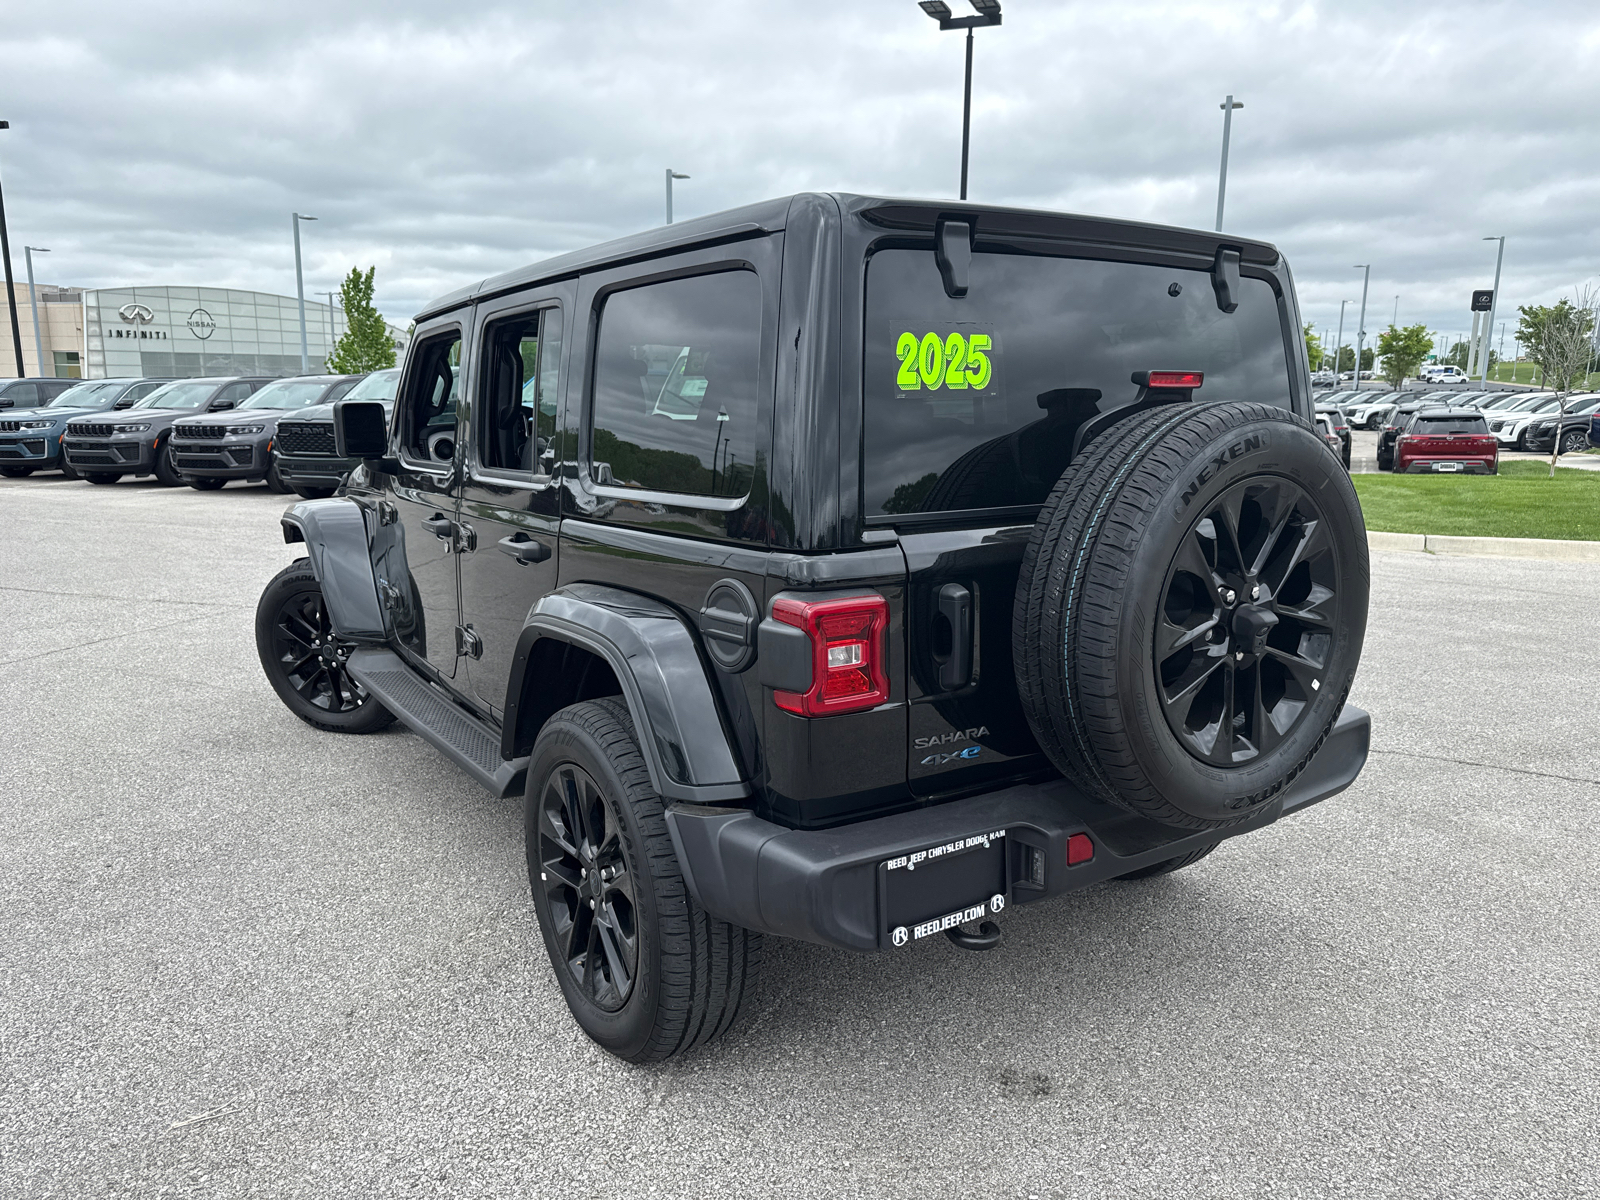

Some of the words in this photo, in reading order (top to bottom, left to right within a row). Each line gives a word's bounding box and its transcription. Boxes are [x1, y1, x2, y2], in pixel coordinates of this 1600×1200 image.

[109, 329, 167, 340] INFINITI
[186, 320, 216, 328] NISSAN
[896, 331, 992, 391] 2025
[291, 427, 325, 435] RAM
[1180, 435, 1261, 507] NEXEN
[281, 574, 317, 588] ROADIA
[914, 725, 990, 750] SAHARA
[887, 856, 907, 870] REED
[910, 850, 927, 865] JEEP
[928, 839, 965, 859] CHRYSLER
[965, 833, 989, 848] DODGE
[914, 904, 985, 940] REEDJEEP.COM
